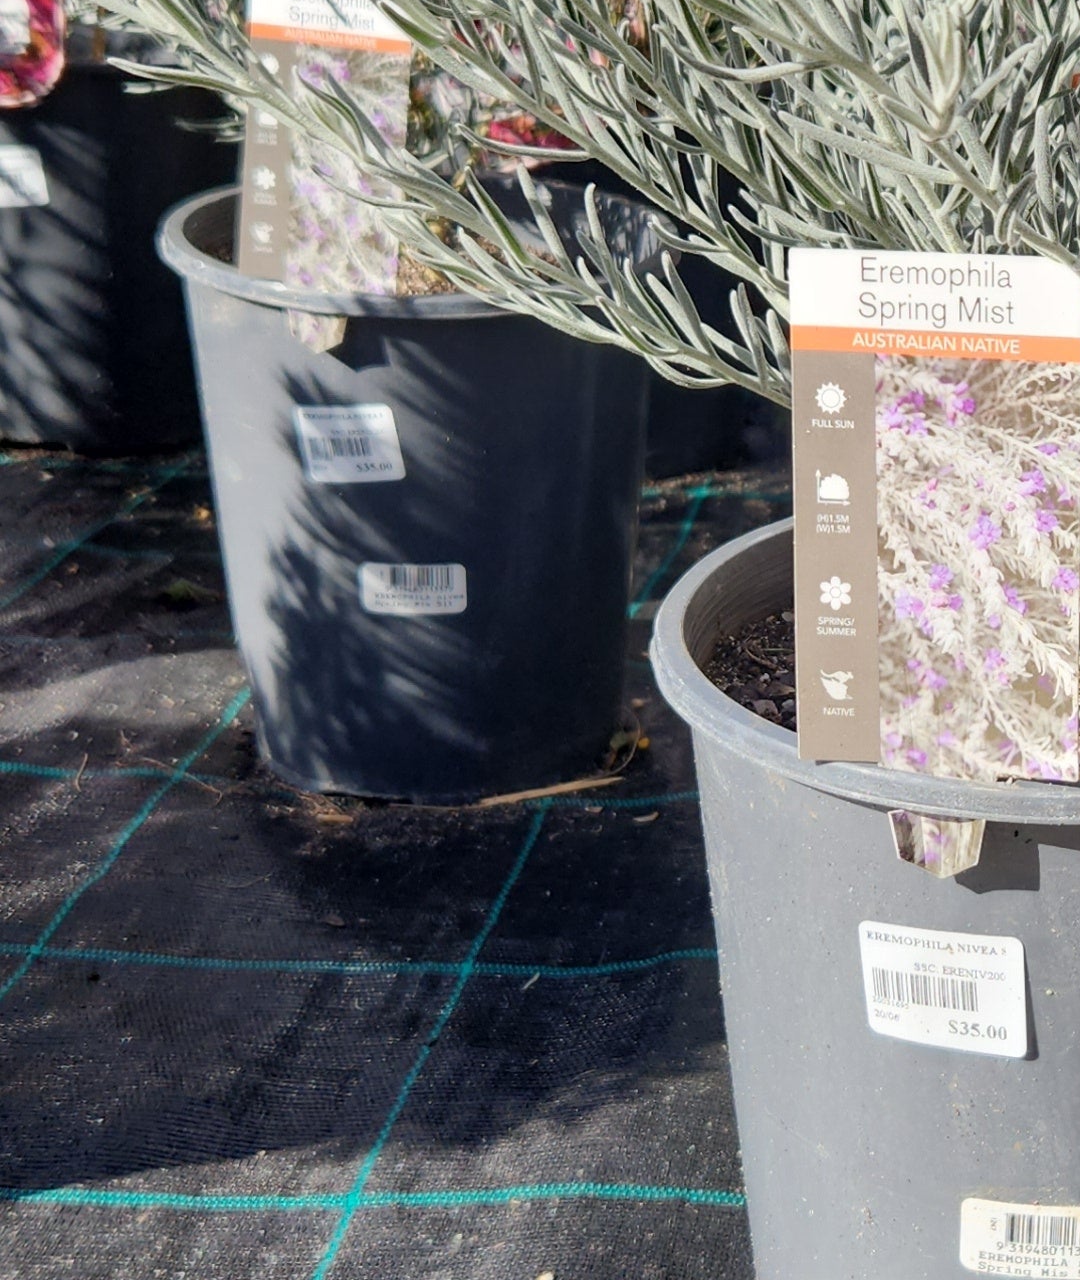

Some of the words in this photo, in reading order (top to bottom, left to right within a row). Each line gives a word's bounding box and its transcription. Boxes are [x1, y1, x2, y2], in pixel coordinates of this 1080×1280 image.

[289, 5, 339, 30] Spring
[860, 256, 1012, 293] Eremophila
[858, 292, 947, 329] Spring
[958, 296, 1014, 325] Mist
[852, 332, 958, 351] AUSTRALIAN
[961, 337, 1021, 354] NATIVE
[812, 418, 833, 428] FULL
[835, 419, 855, 429] SUN
[816, 524, 851, 534] (W)1.5M
[817, 616, 855, 626] SPRING/
[816, 626, 857, 636] SUMMER
[823, 707, 856, 717] NATIVE
[866, 930, 954, 951] EREMOPHILA
[957, 943, 998, 956] NIVEA
[949, 1020, 1008, 1041] $35.00
[979, 1251, 1069, 1267] EREMOPHILA
[977, 1261, 1032, 1276] Spring
